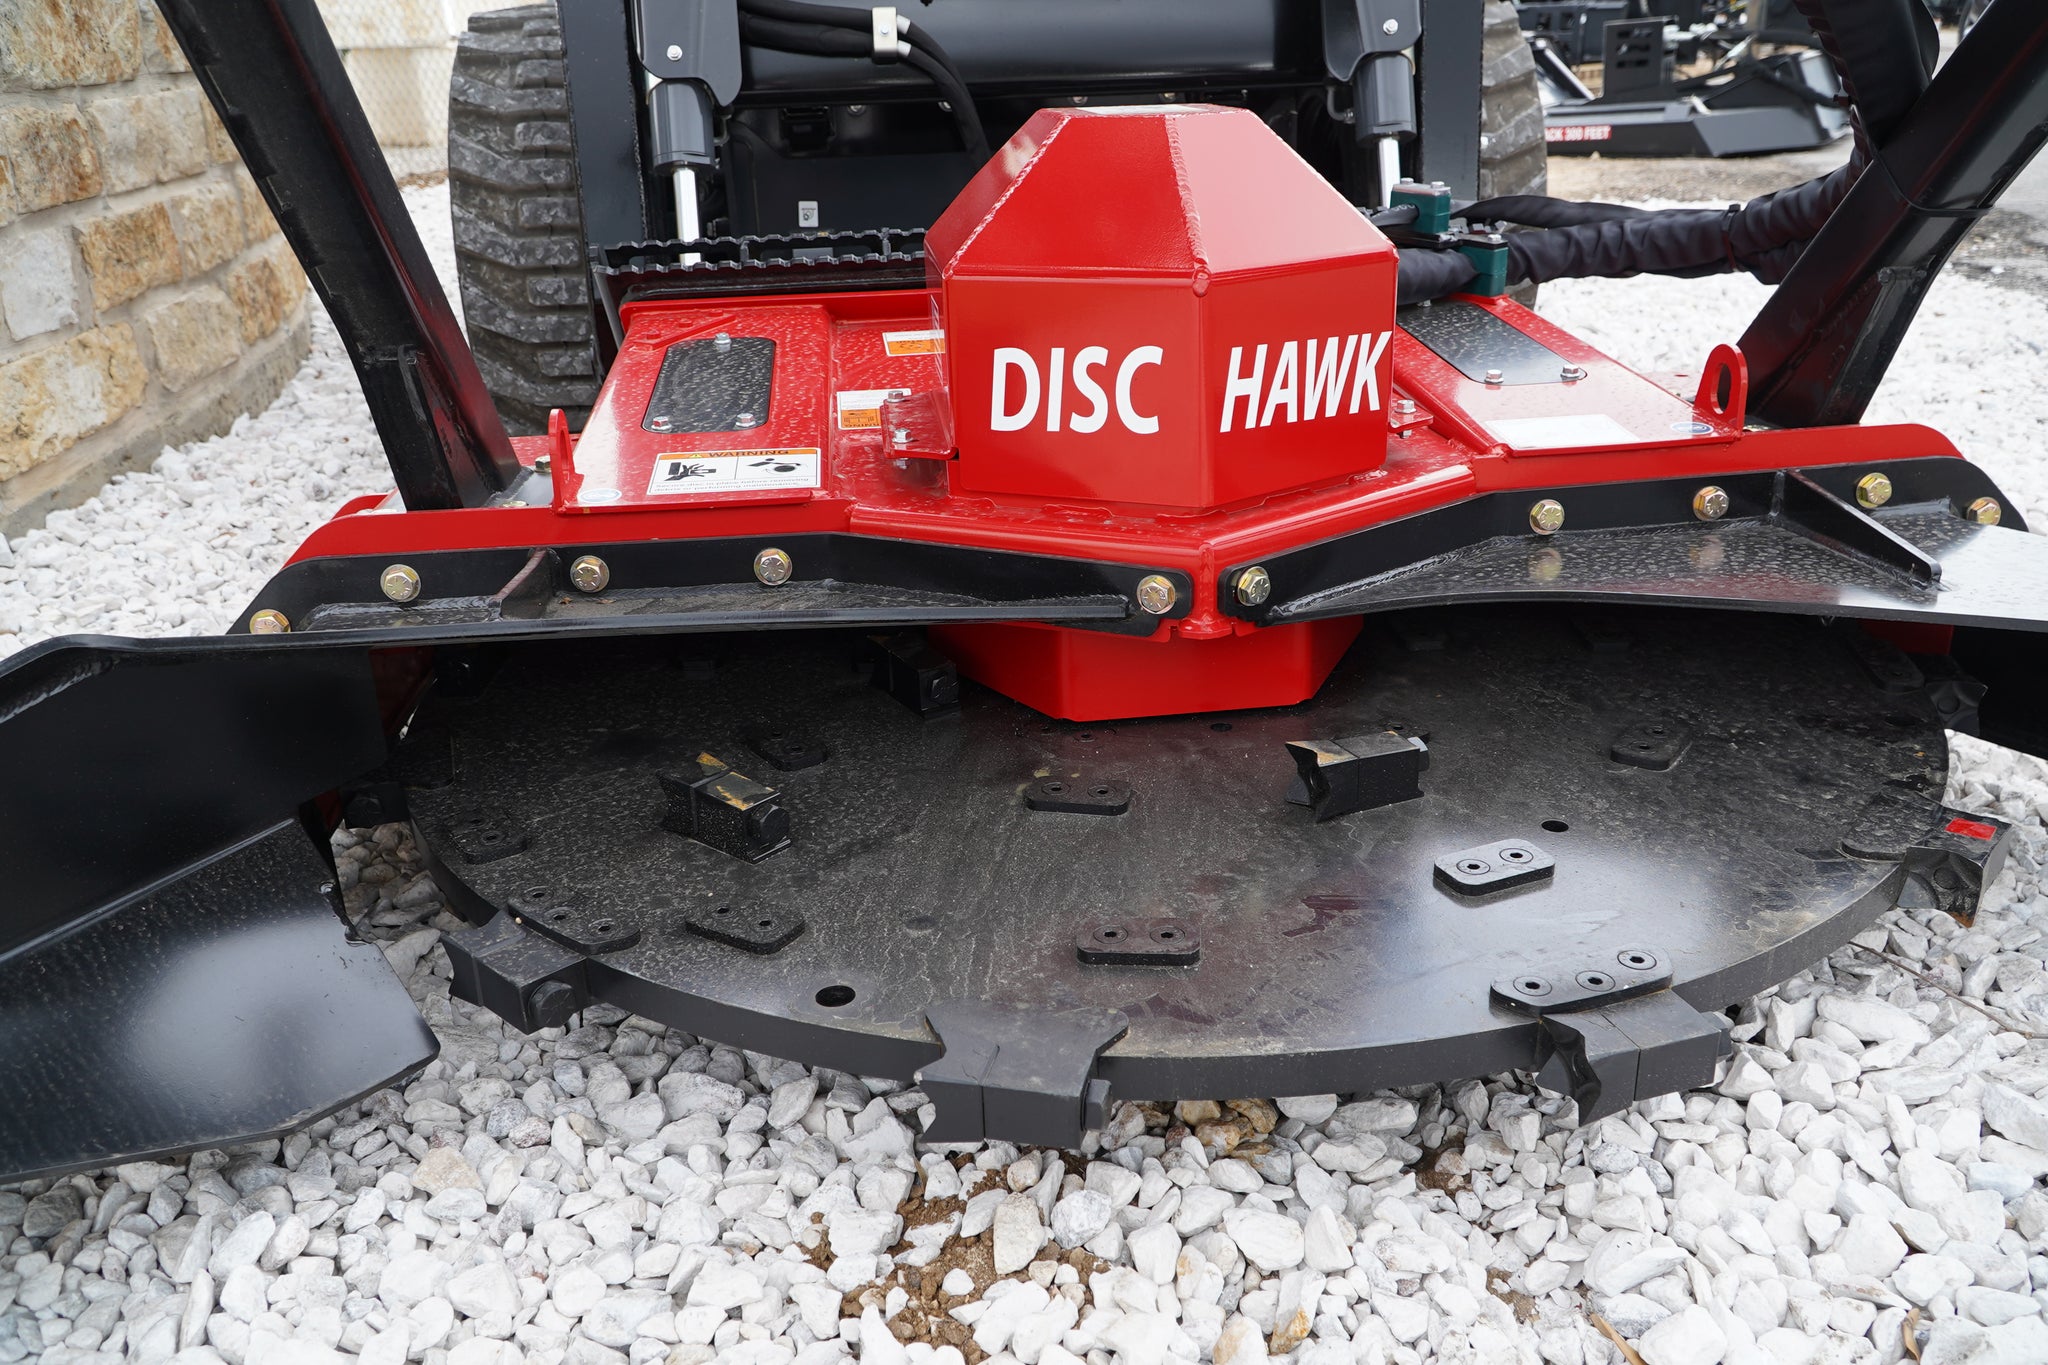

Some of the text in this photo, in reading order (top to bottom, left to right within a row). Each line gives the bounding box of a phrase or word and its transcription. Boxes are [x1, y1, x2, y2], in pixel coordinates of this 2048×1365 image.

[1584, 125, 1611, 140] FEET
[991, 345, 1163, 434] DISC
[1220, 331, 1393, 433] HAWK
